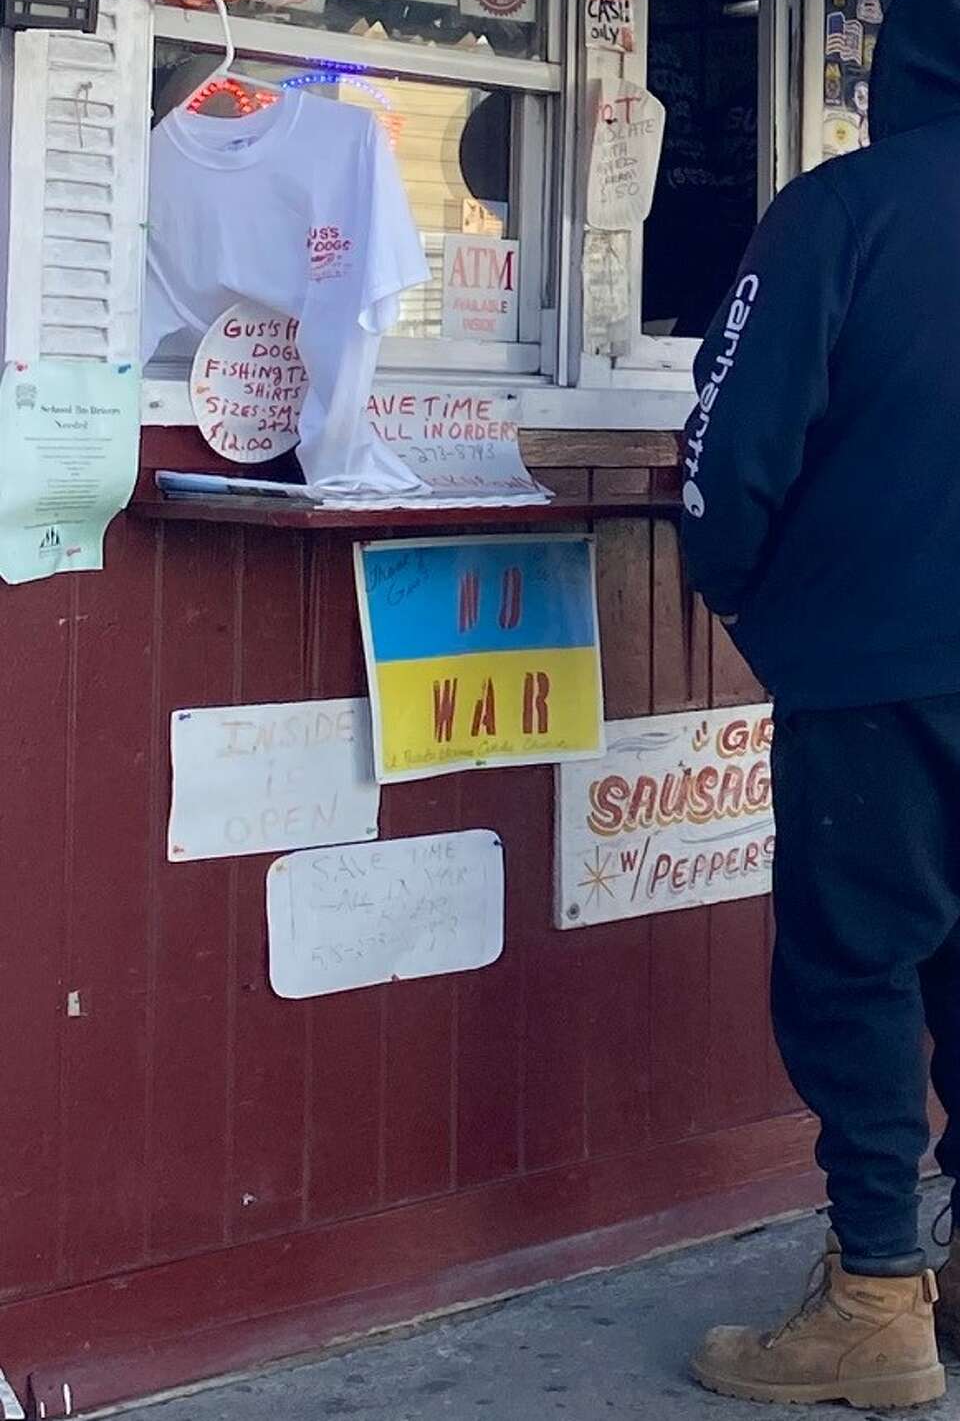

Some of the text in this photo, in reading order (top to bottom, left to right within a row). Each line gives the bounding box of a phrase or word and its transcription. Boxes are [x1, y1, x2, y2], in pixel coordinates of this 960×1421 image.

[594, 95, 642, 125] OT
[447, 245, 515, 291] ATM
[366, 393, 417, 418] AVE
[685, 274, 759, 478] carhartt
[458, 566, 524, 635] NO
[432, 671, 550, 744] WAR
[223, 789, 339, 845] OPEN
[586, 761, 773, 837] SAUSAG
